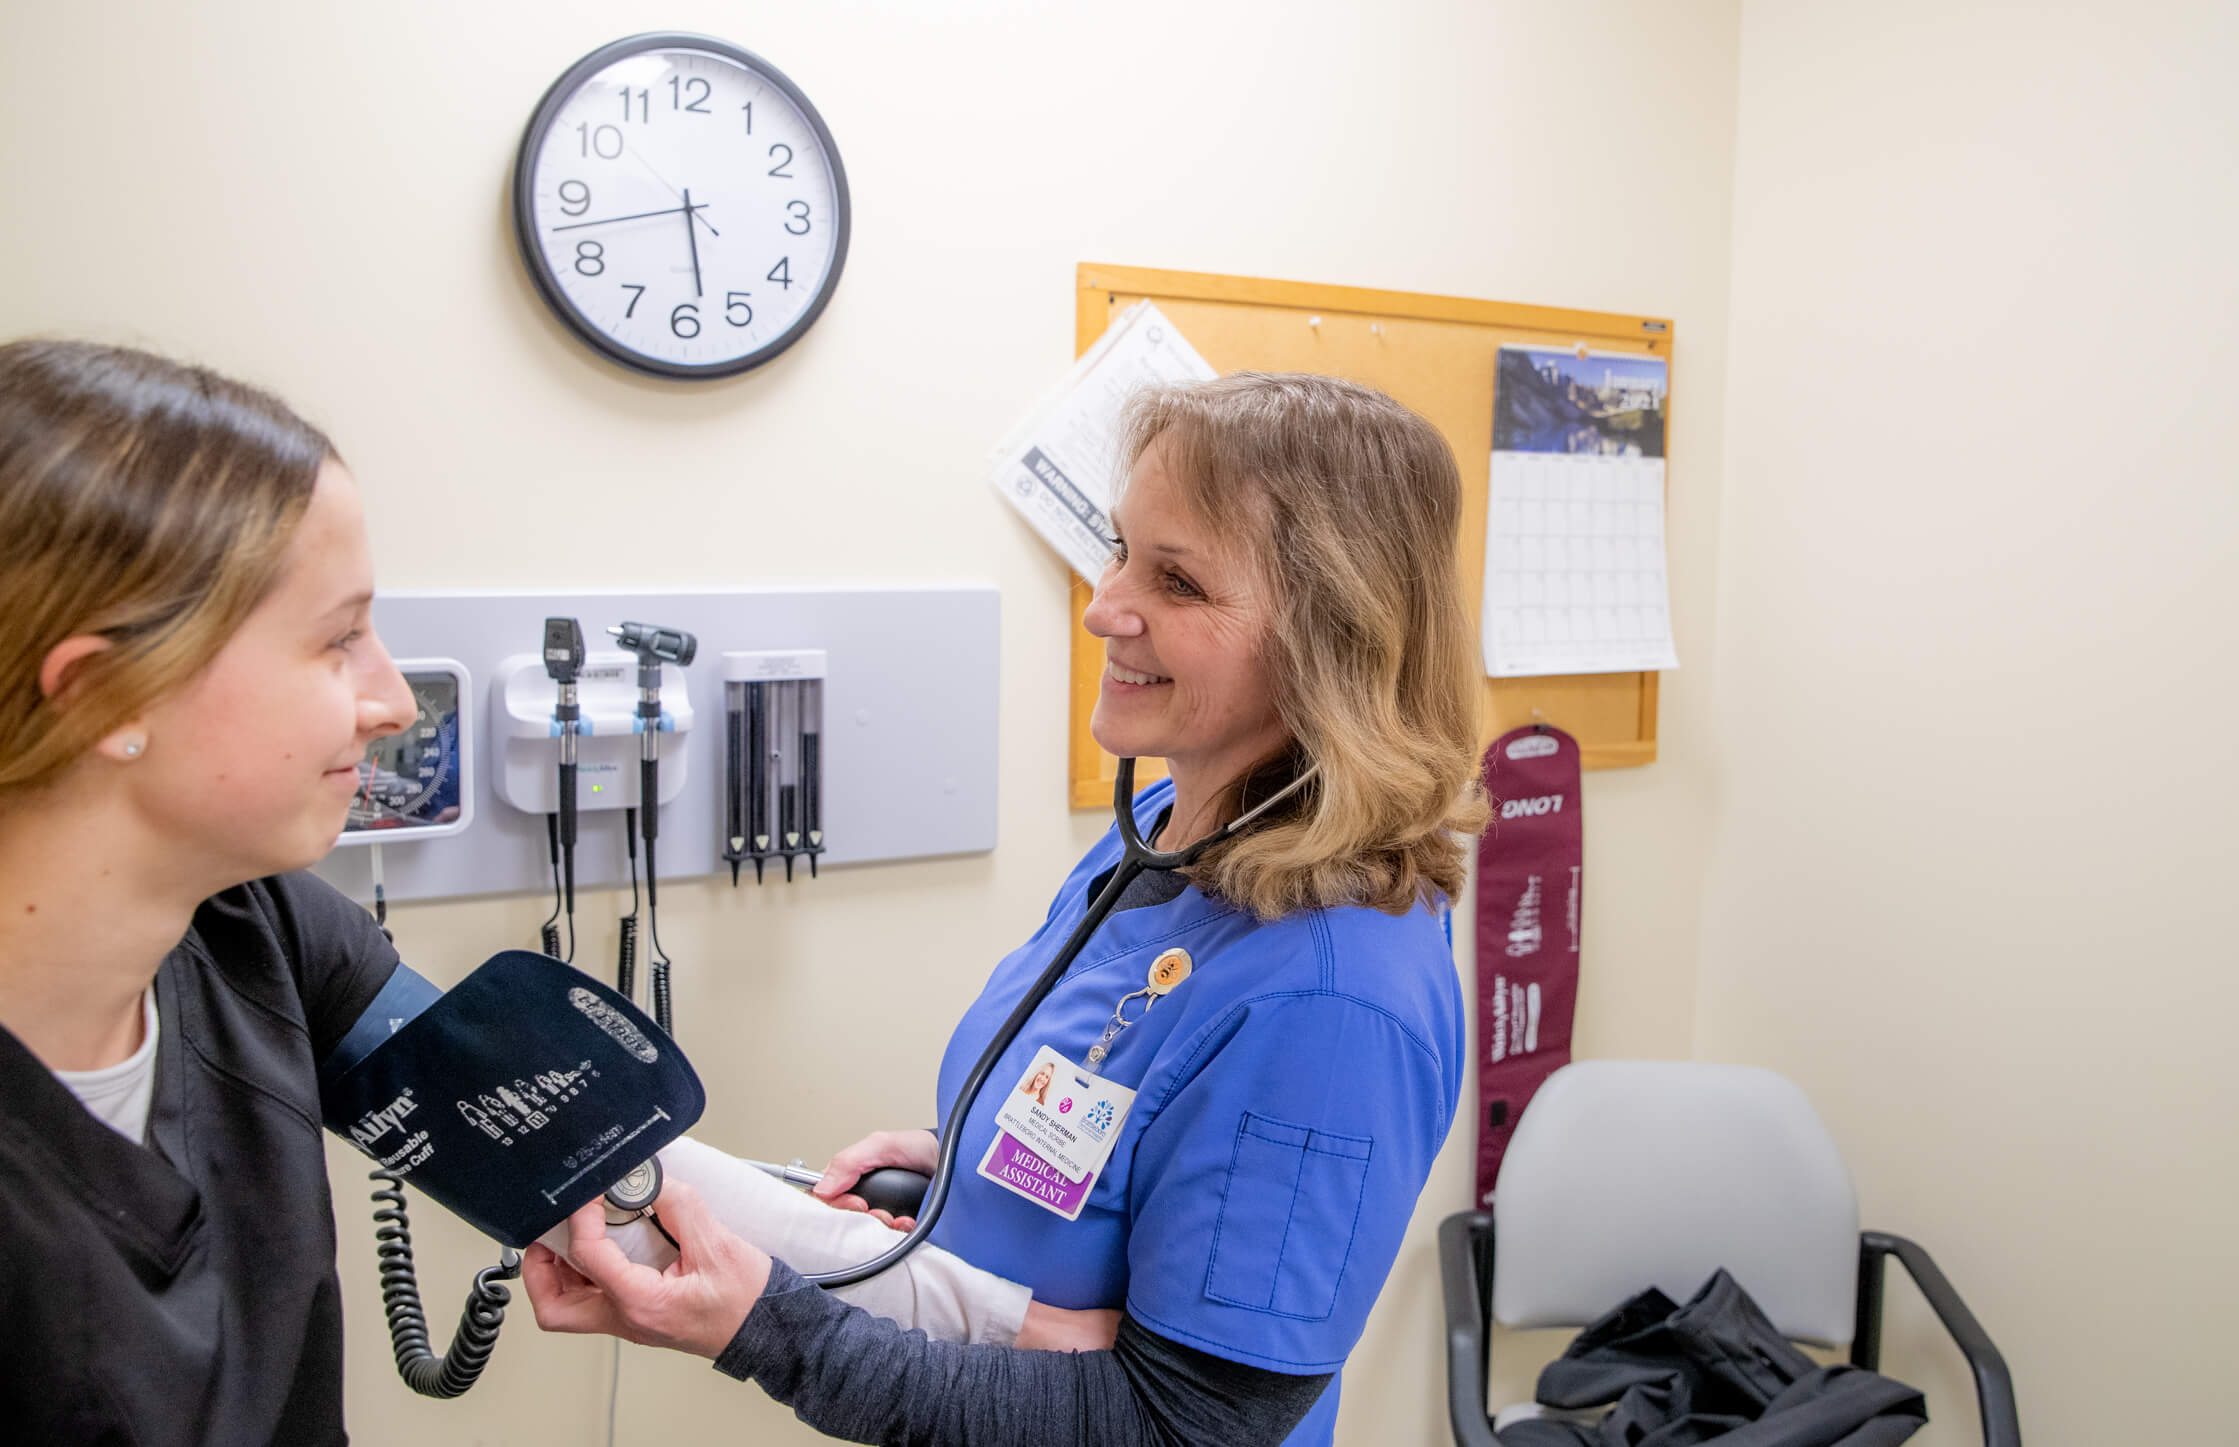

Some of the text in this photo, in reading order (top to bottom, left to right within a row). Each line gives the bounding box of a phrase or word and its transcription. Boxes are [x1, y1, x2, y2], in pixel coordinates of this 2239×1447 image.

[618, 86, 650, 124] 11
[668, 74, 712, 114] 12
[741, 101, 753, 135] 1
[576, 121, 624, 160] 10
[767, 143, 793, 178] 2
[558, 179, 591, 217] 9
[784, 200, 812, 235] 3
[574, 240, 605, 277] 8
[766, 256, 793, 290] 4
[620, 284, 646, 319] 7
[725, 291, 753, 327] 5
[670, 304, 700, 339] 6
[388, 795, 406, 806] 300
[1501, 794, 1563, 819] LONG
[518, 1125, 530, 1135] 12
[560, 1094, 569, 1103] 9
[569, 1087, 579, 1096] 8
[579, 1079, 588, 1088] 7
[1030, 1106, 1050, 1123] SANDY
[1049, 1119, 1077, 1143] SHERMAN
[1028, 1117, 1048, 1135] MEDICAL
[380, 1130, 429, 1167] Reusable
[409, 1142, 435, 1167] Cuff
[1035, 1136, 1058, 1157] INTERNAL
[1058, 1153, 1081, 1173] MEDICINE
[1000, 1164, 1067, 1205] ASSISTANT
[1011, 1149, 1068, 1187] MEDICAL
